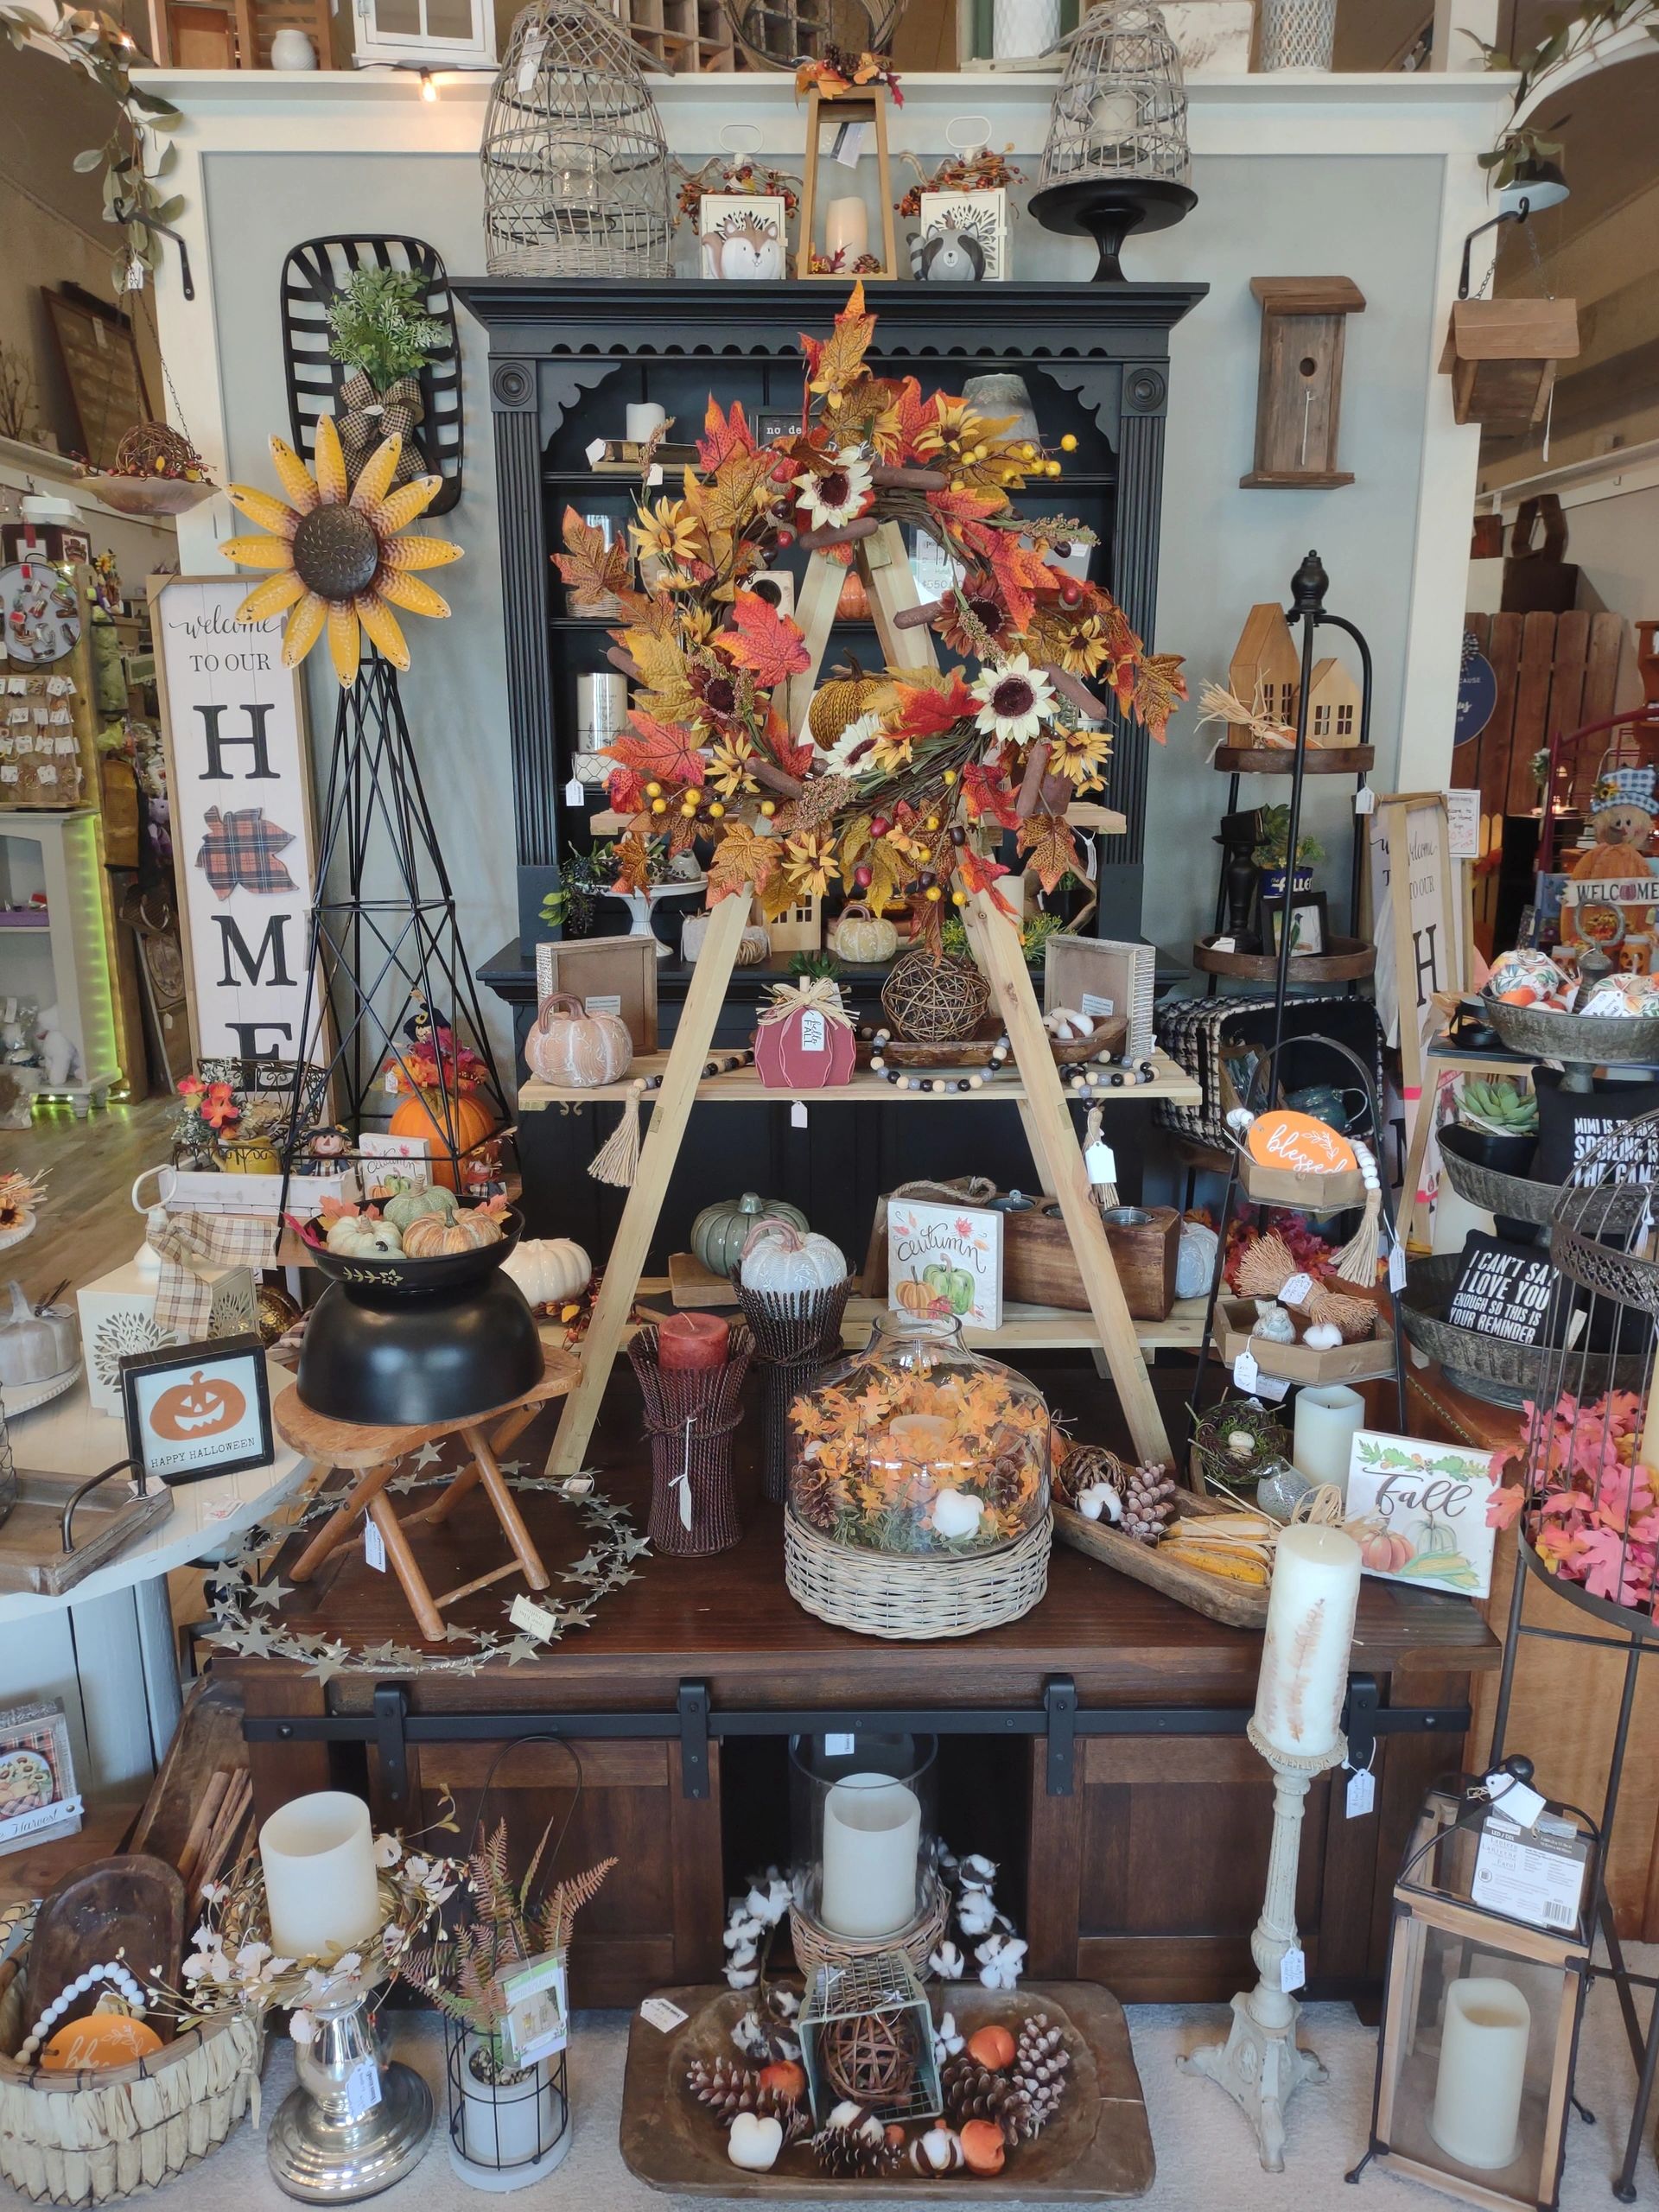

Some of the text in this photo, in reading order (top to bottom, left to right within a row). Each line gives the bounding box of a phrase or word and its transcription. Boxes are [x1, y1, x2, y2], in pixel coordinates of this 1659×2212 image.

[189, 653, 271, 672] TO OUR
[804, 1020, 812, 1047] FALL
[1574, 1117, 1600, 1134] MIMI
[1602, 1119, 1613, 1135] IS
[1469, 1249, 1479, 1268] I
[1478, 1252, 1525, 1277] CAN'T
[1459, 1269, 1550, 1311] I LOVE YOU
[1452, 1293, 1542, 1326] ENOUGH SO THIS IS
[1449, 1307, 1536, 1344] YOUR REMINDER
[150, 1437, 255, 1468] HAPPY HALLOWEEN
[1363, 1467, 1472, 1517] Fall
[10, 1808, 58, 1835] Harvest
